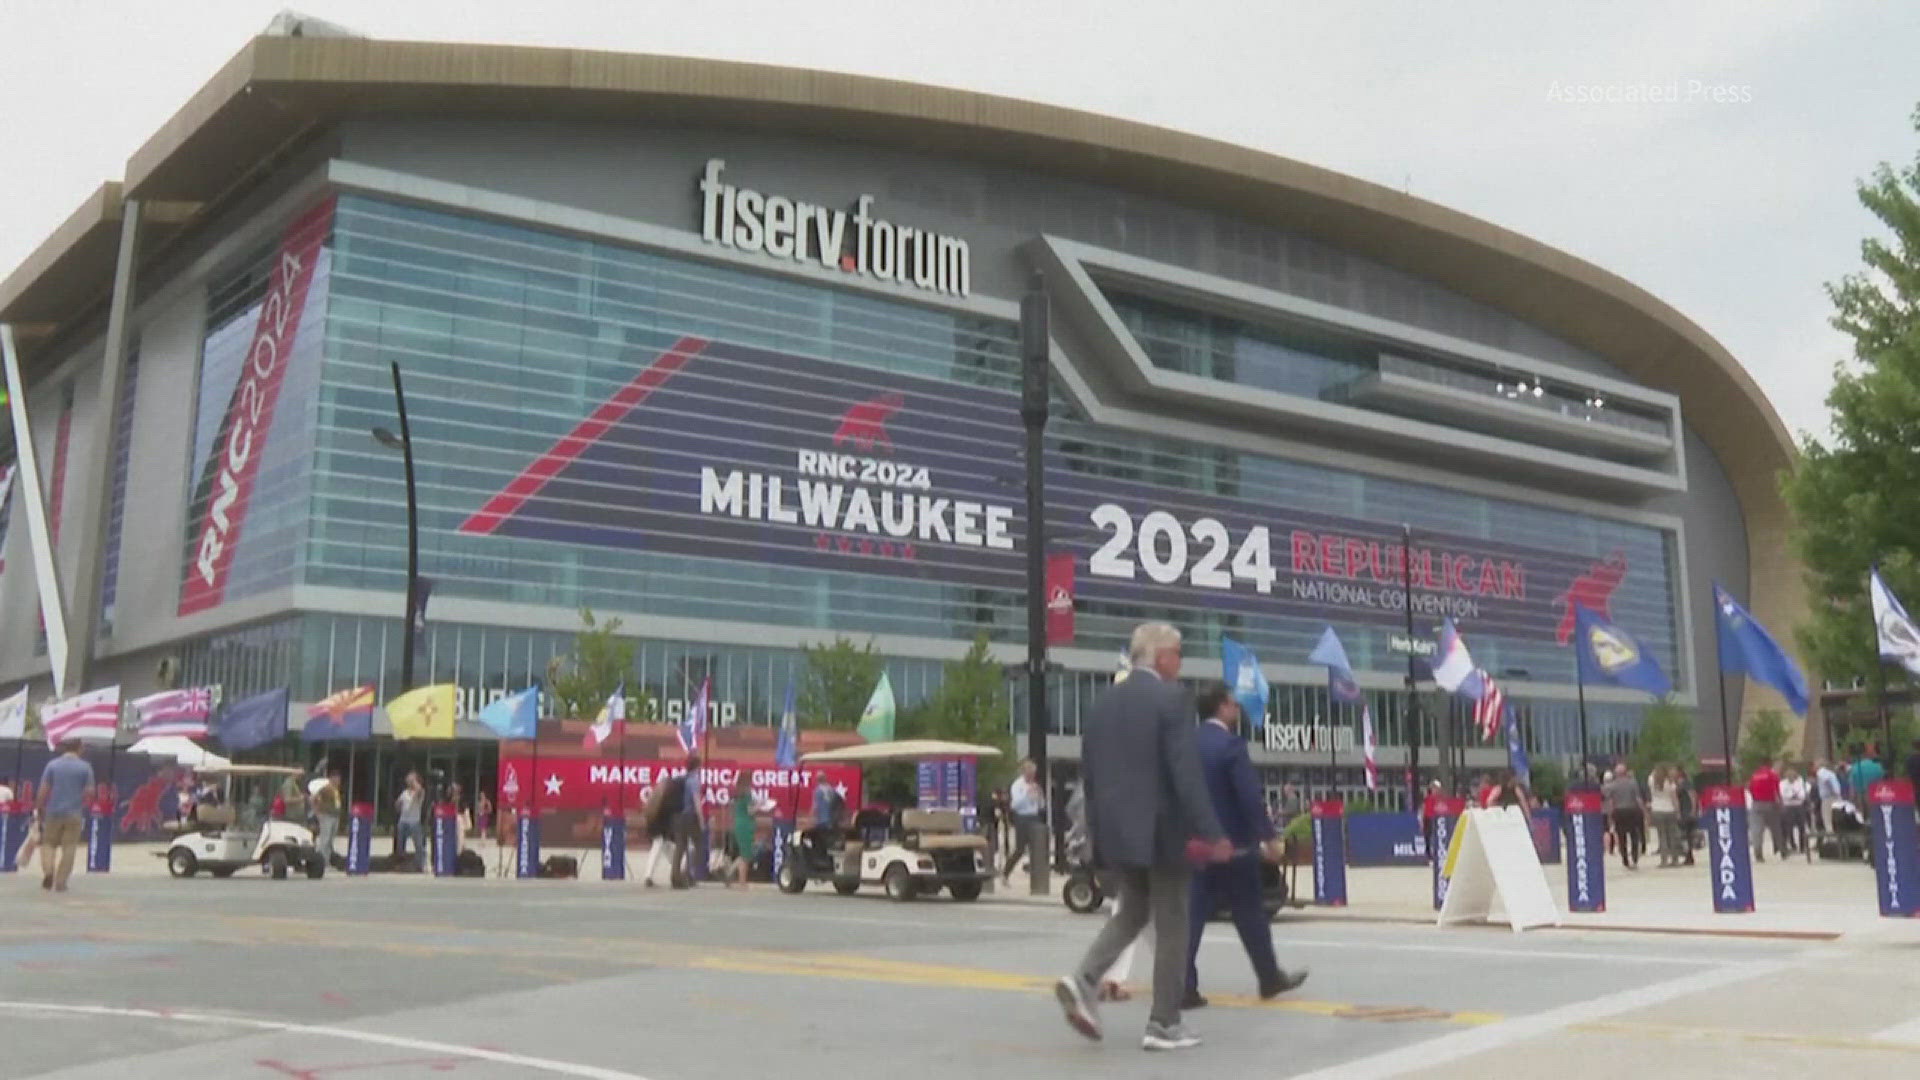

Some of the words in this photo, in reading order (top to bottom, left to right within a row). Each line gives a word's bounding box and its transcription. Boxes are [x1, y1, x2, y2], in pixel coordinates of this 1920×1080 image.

[700, 466, 1014, 549] MILWAUKEE
[1089, 503, 1277, 594] 2024
[1290, 529, 1526, 601] REPUBLICAN
[1292, 579, 1376, 608] NATIONAL
[590, 765, 652, 784] MAKE
[656, 767, 740, 786] AMRIC
[751, 768, 812, 788] GREAT
[1572, 813, 1589, 902] NEBRASKA
[1716, 807, 1736, 900] NEVADA
